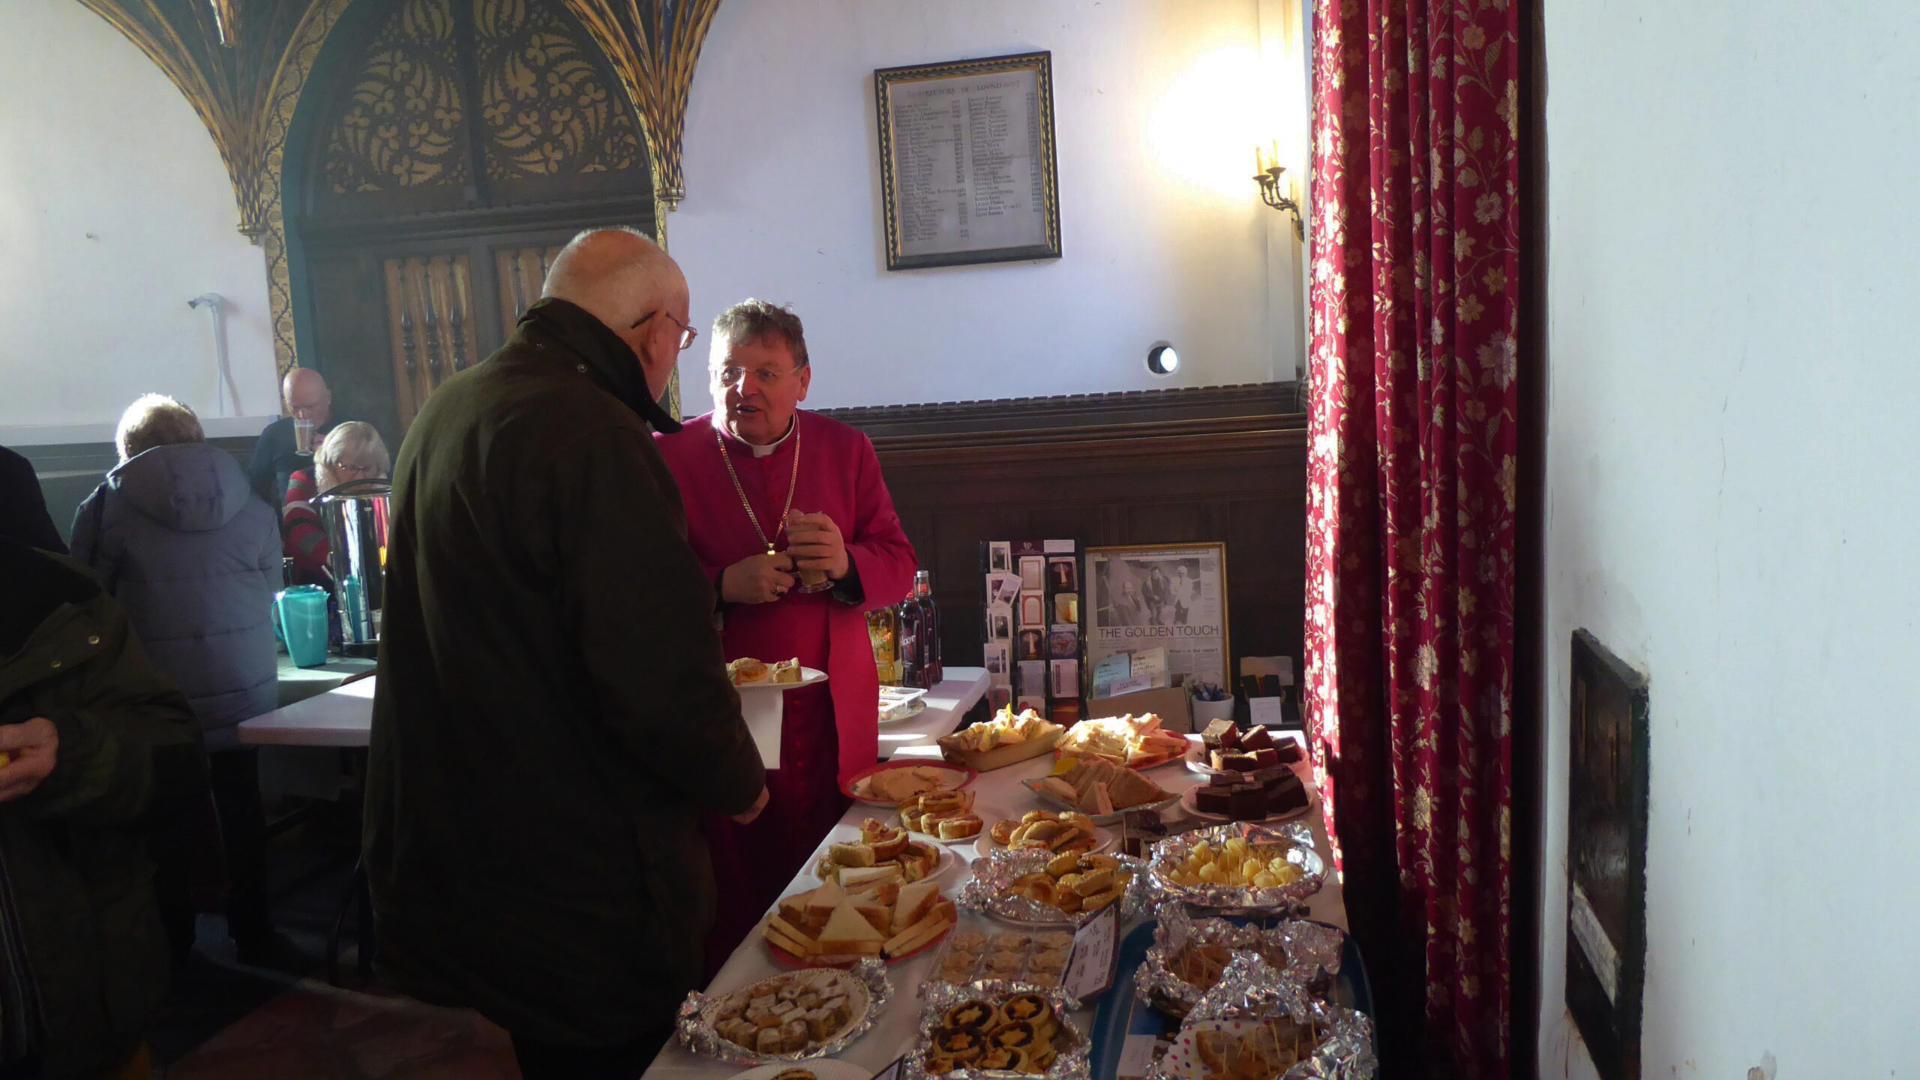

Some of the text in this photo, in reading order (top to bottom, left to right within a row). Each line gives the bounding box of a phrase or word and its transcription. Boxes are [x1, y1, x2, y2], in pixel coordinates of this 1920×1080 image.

[1098, 625, 1219, 638] THE GOLDEN TOUCH
